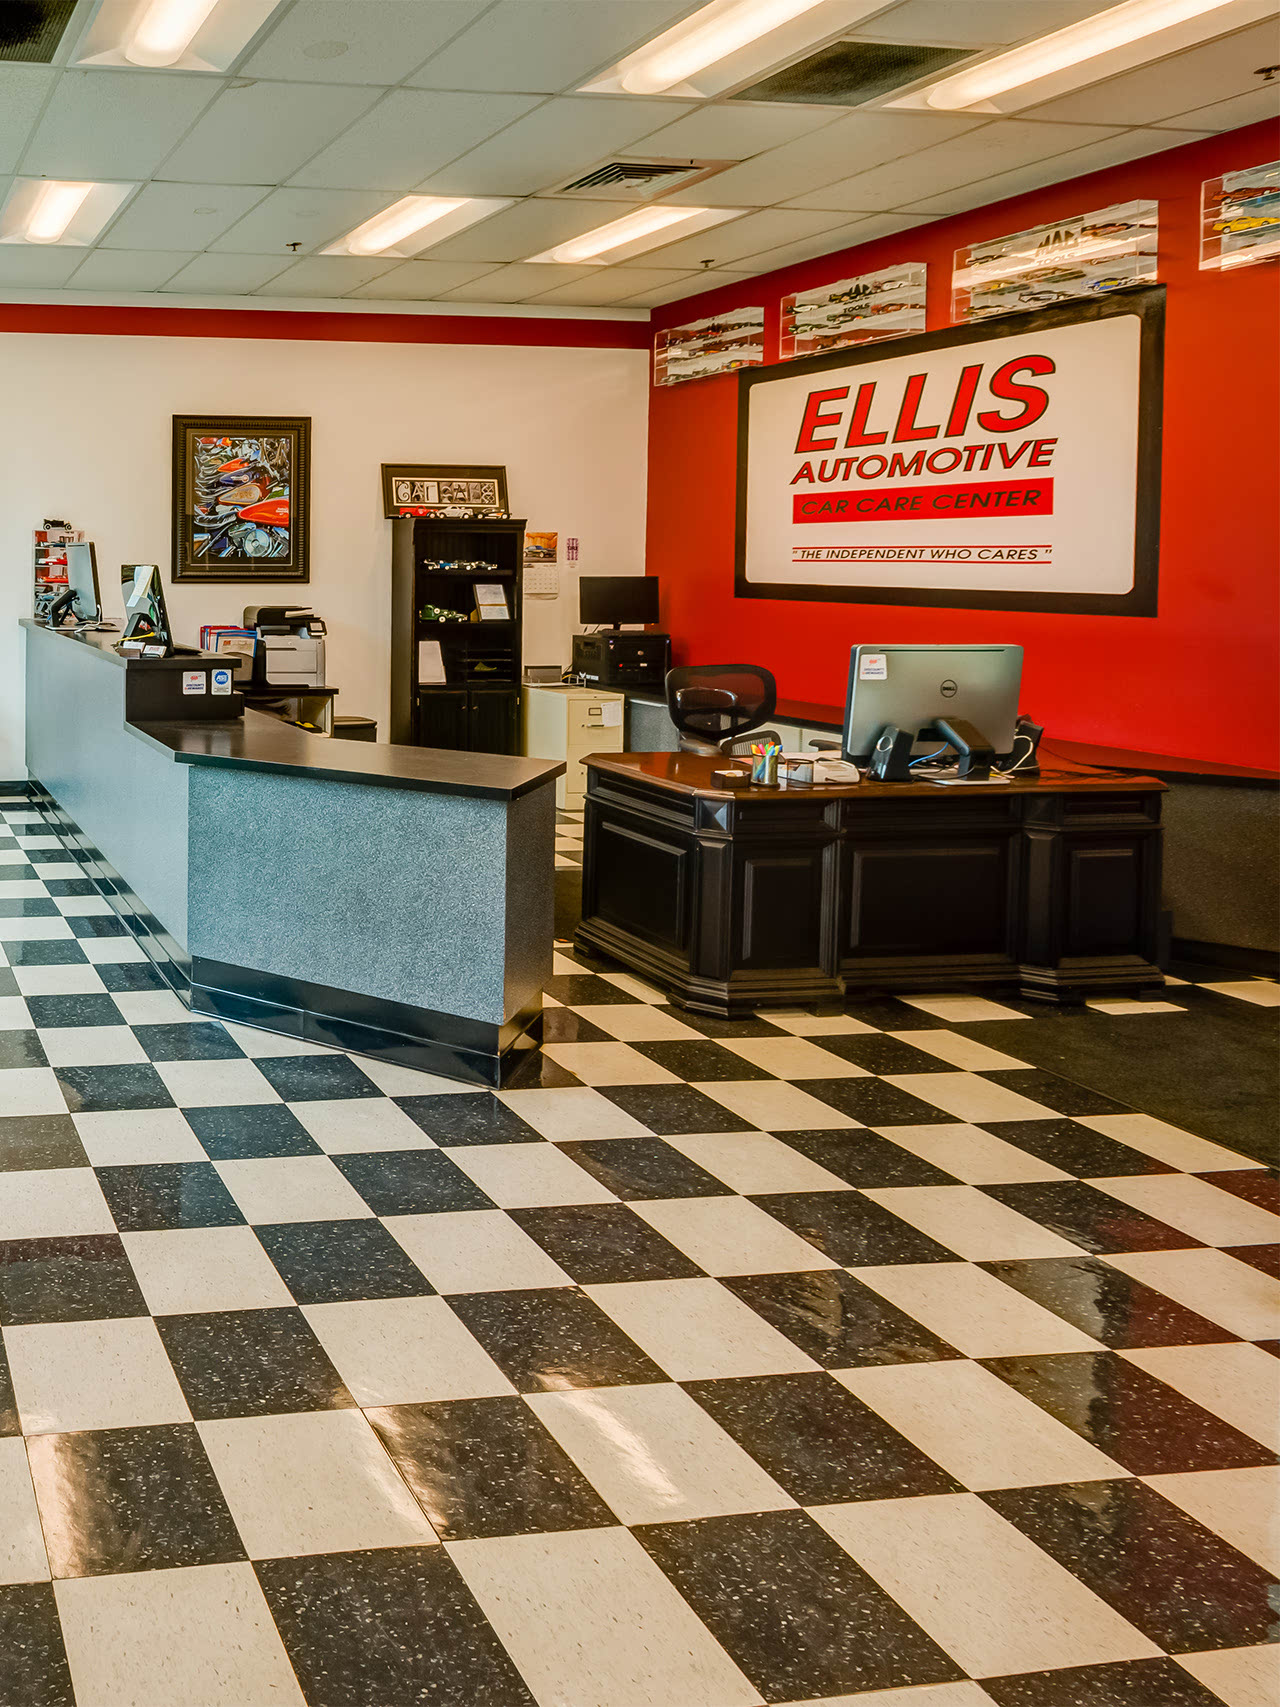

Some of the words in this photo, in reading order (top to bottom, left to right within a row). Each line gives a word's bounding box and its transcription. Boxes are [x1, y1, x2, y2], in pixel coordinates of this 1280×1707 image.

[843, 302, 870, 314] TOOLS
[794, 354, 1057, 455] ELLIS
[789, 437, 1059, 486] AUTOMOTIVE
[801, 500, 849, 515] CAR
[856, 495, 924, 514] CARE
[932, 489, 1042, 510] CENTER
[800, 549, 822, 560] THE
[825, 548, 926, 560] INDEPENDENT
[929, 548, 973, 560] WHO
[976, 548, 1039, 560] CARES
